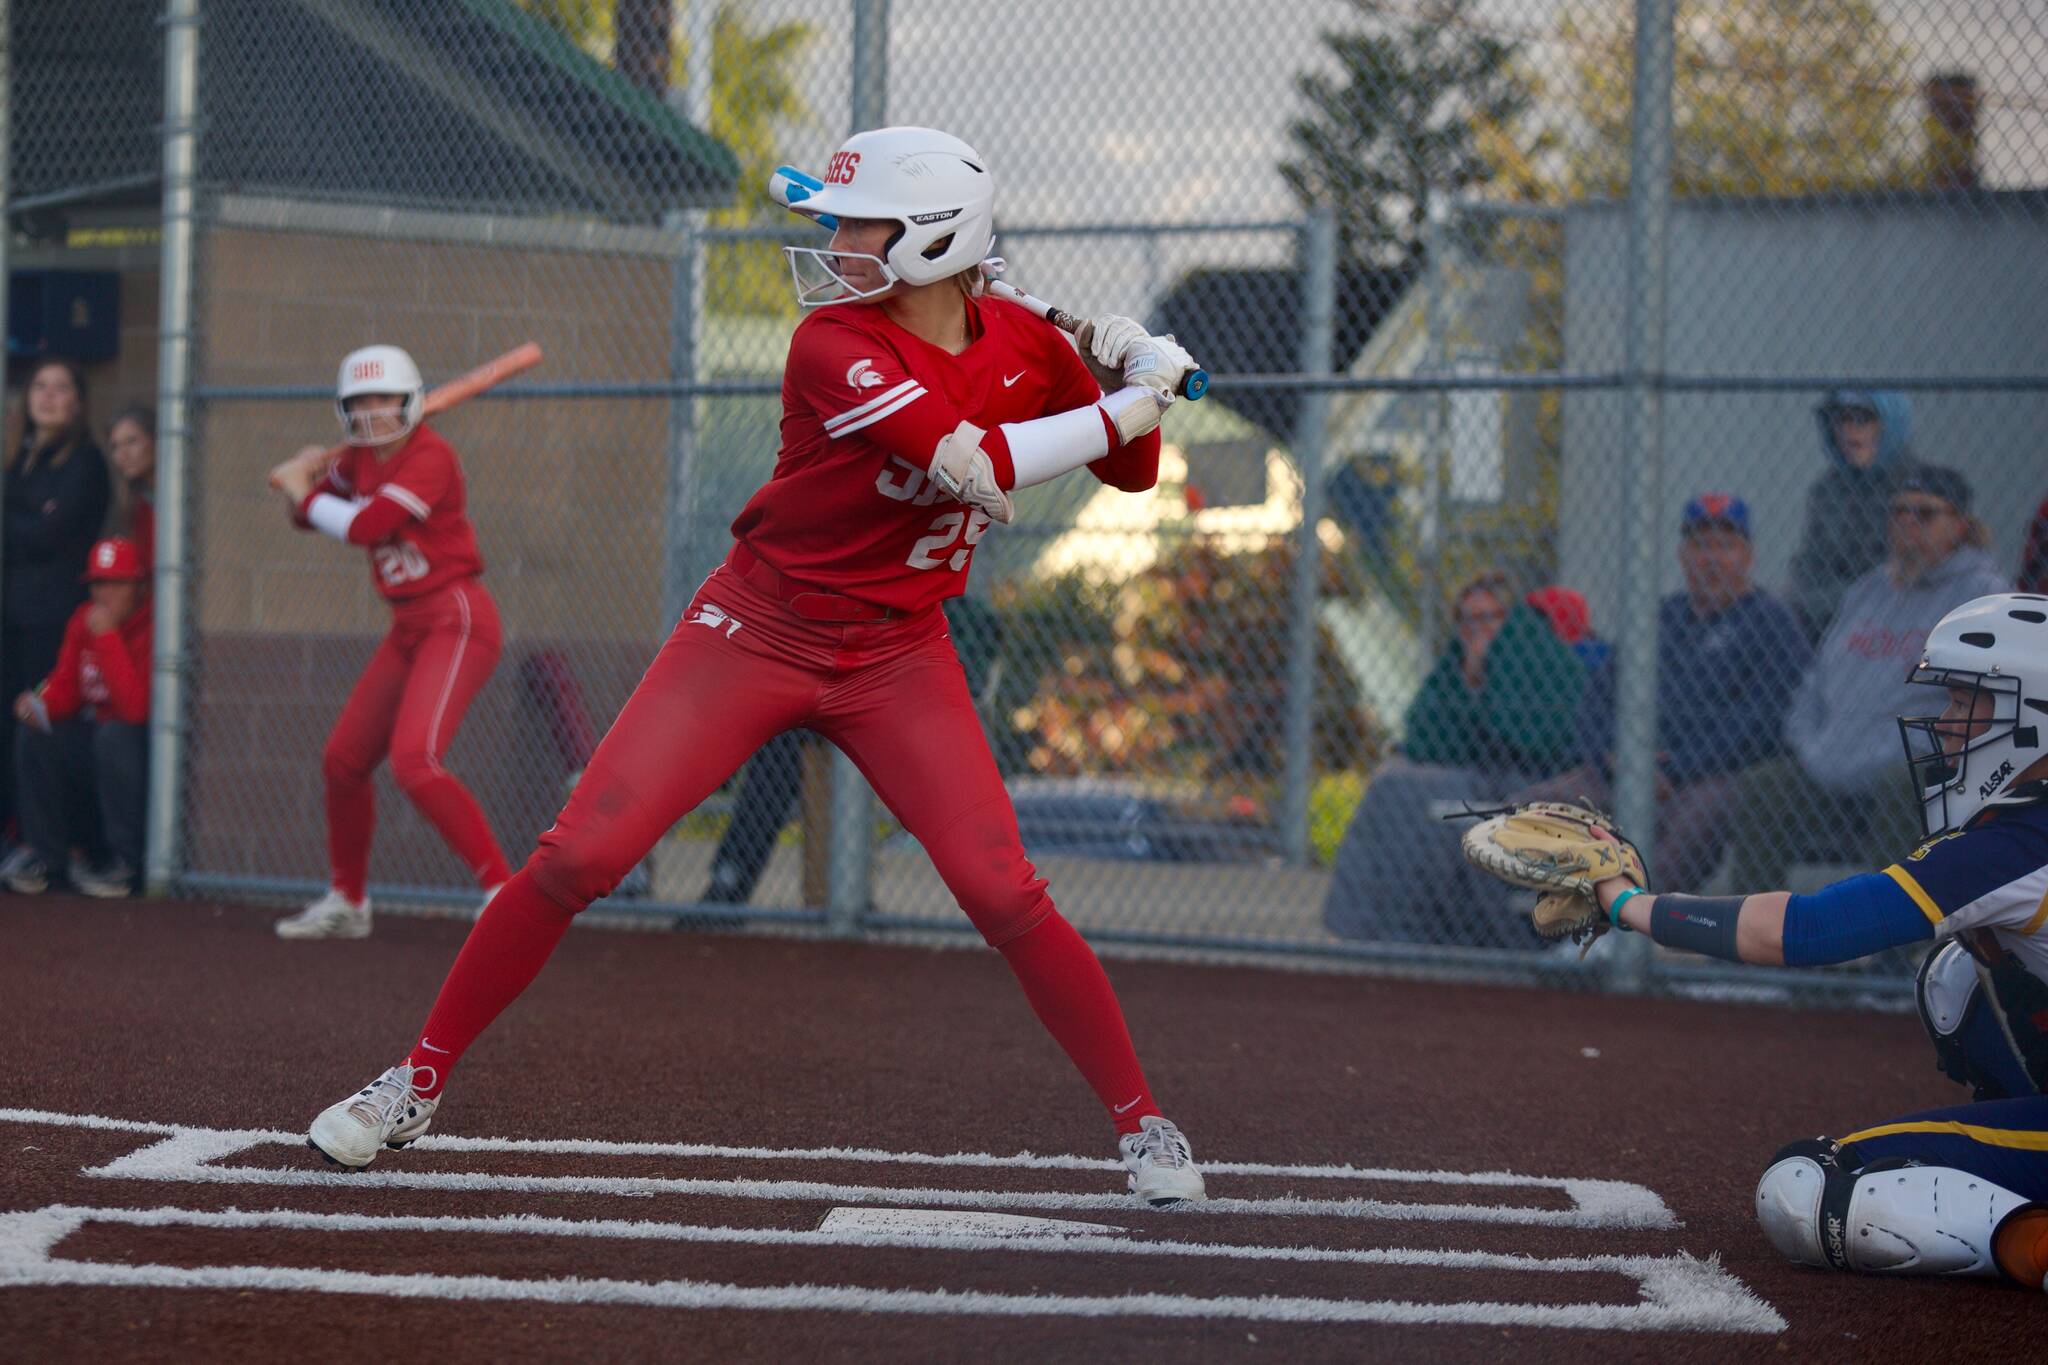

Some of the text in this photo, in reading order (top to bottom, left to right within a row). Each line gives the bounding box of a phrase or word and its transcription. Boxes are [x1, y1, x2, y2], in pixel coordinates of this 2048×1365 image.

[824, 151, 861, 185] SHS
[916, 211, 953, 223] EASTON
[374, 541, 430, 586] 20
